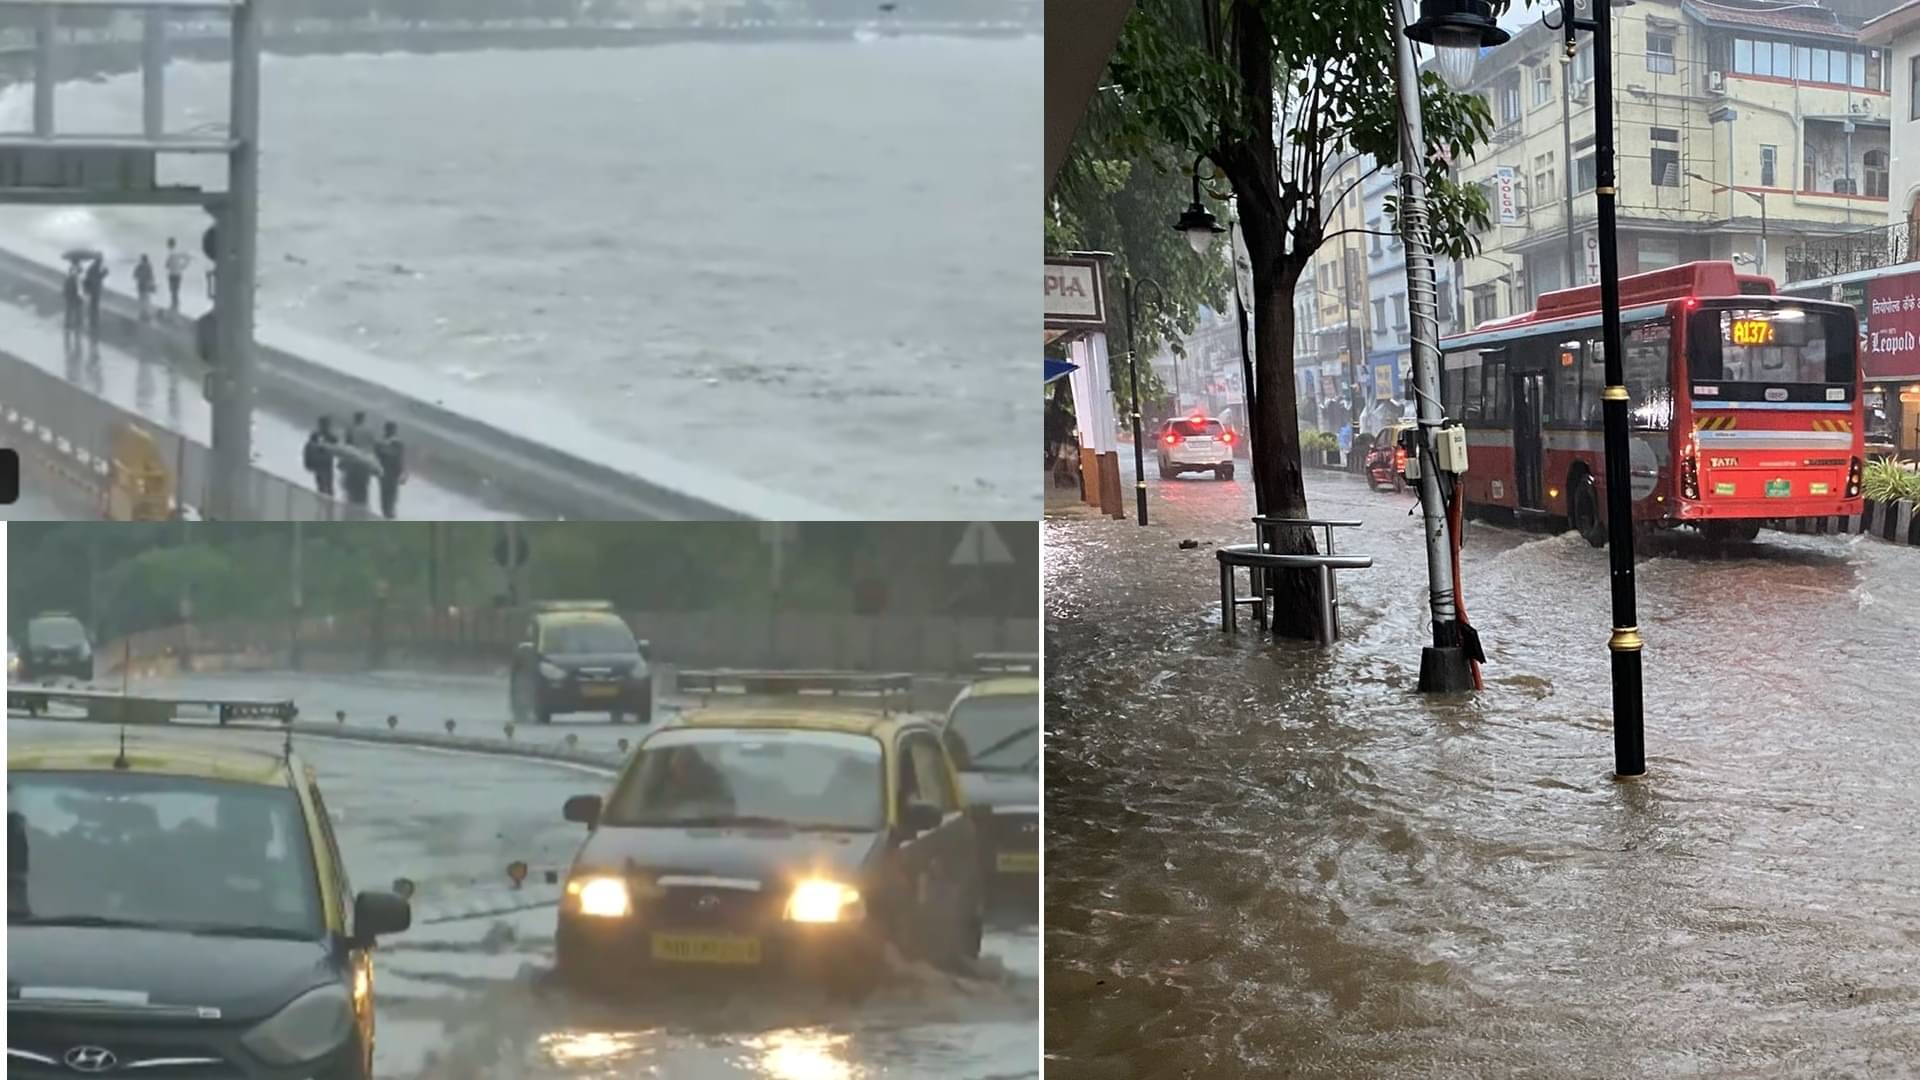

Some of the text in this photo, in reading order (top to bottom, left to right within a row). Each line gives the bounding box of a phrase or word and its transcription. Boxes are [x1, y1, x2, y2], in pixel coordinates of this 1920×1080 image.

[1502, 178, 1512, 214] VOLGA
[1871, 331, 1915, 356] Leopold
[1711, 457, 1738, 468] TATA
